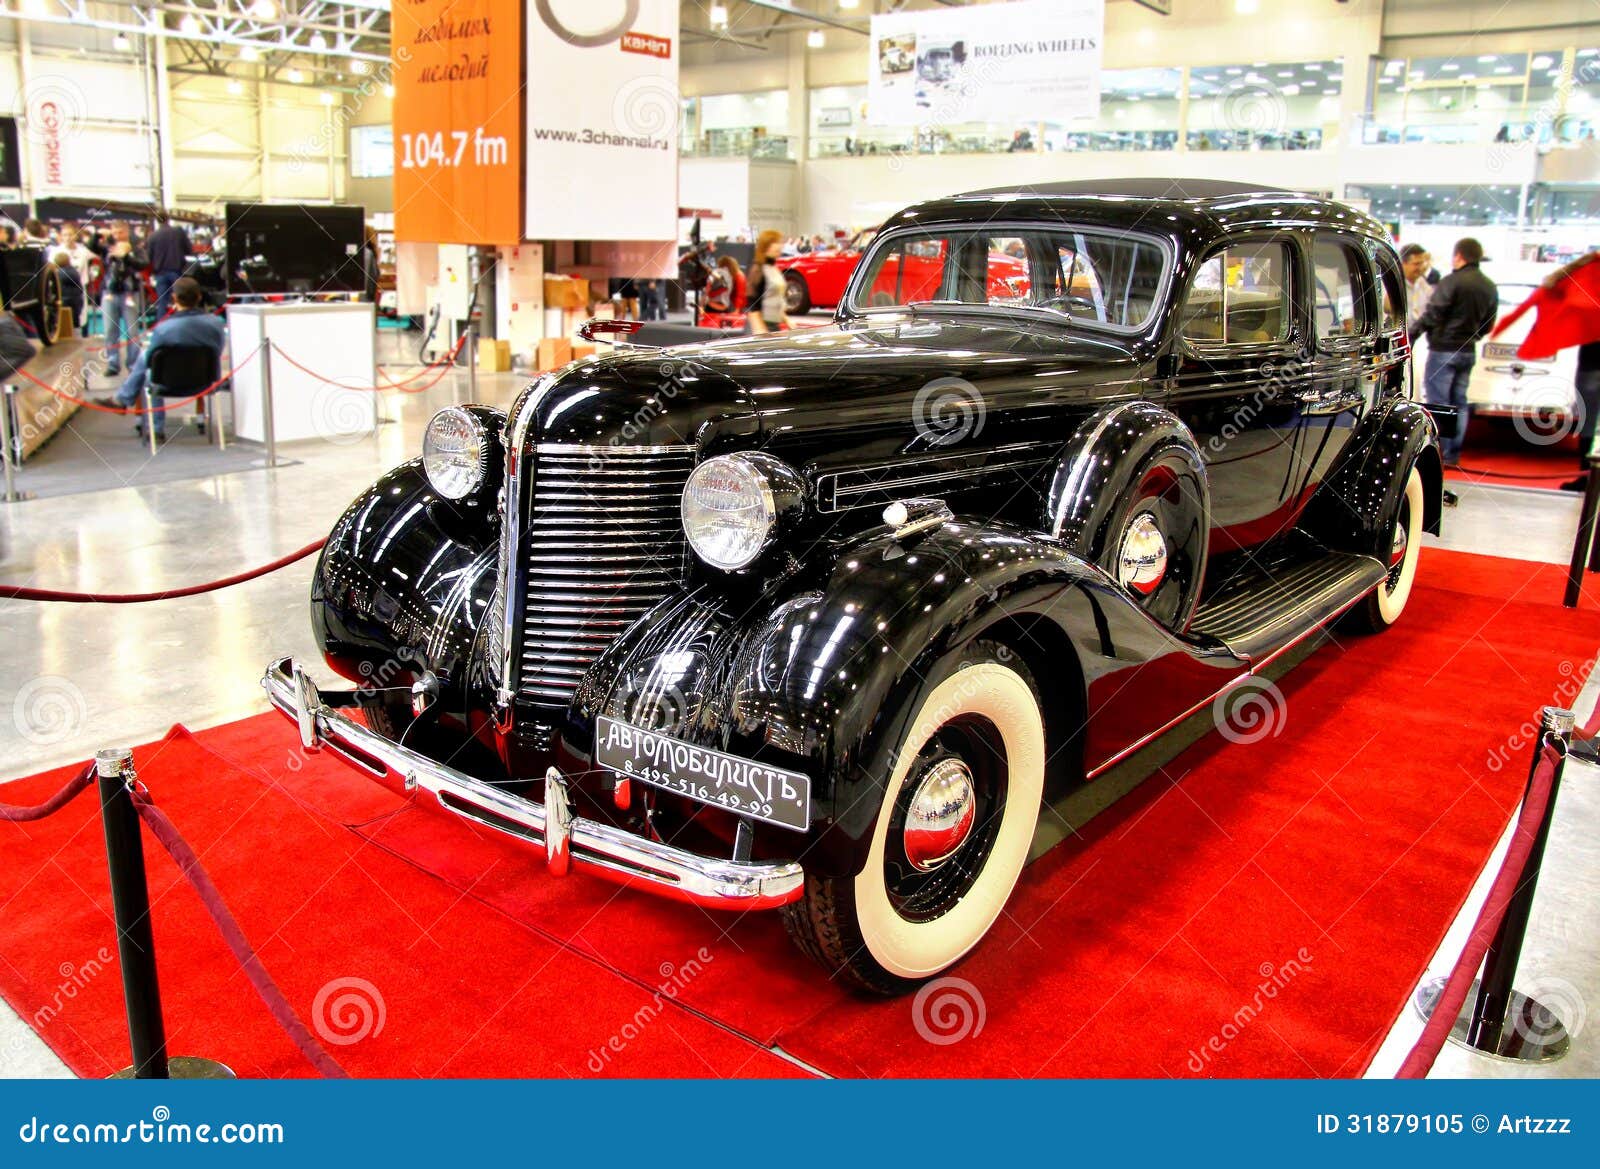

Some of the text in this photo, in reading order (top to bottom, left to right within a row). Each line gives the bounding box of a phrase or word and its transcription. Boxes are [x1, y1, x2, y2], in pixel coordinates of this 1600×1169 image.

[974, 38, 1096, 57] ROLLING WHEELS
[401, 128, 507, 168] 104.7 fm
[534, 127, 669, 151] www.3channel.ru
[624, 759, 773, 818] 8-495-516-49-99
